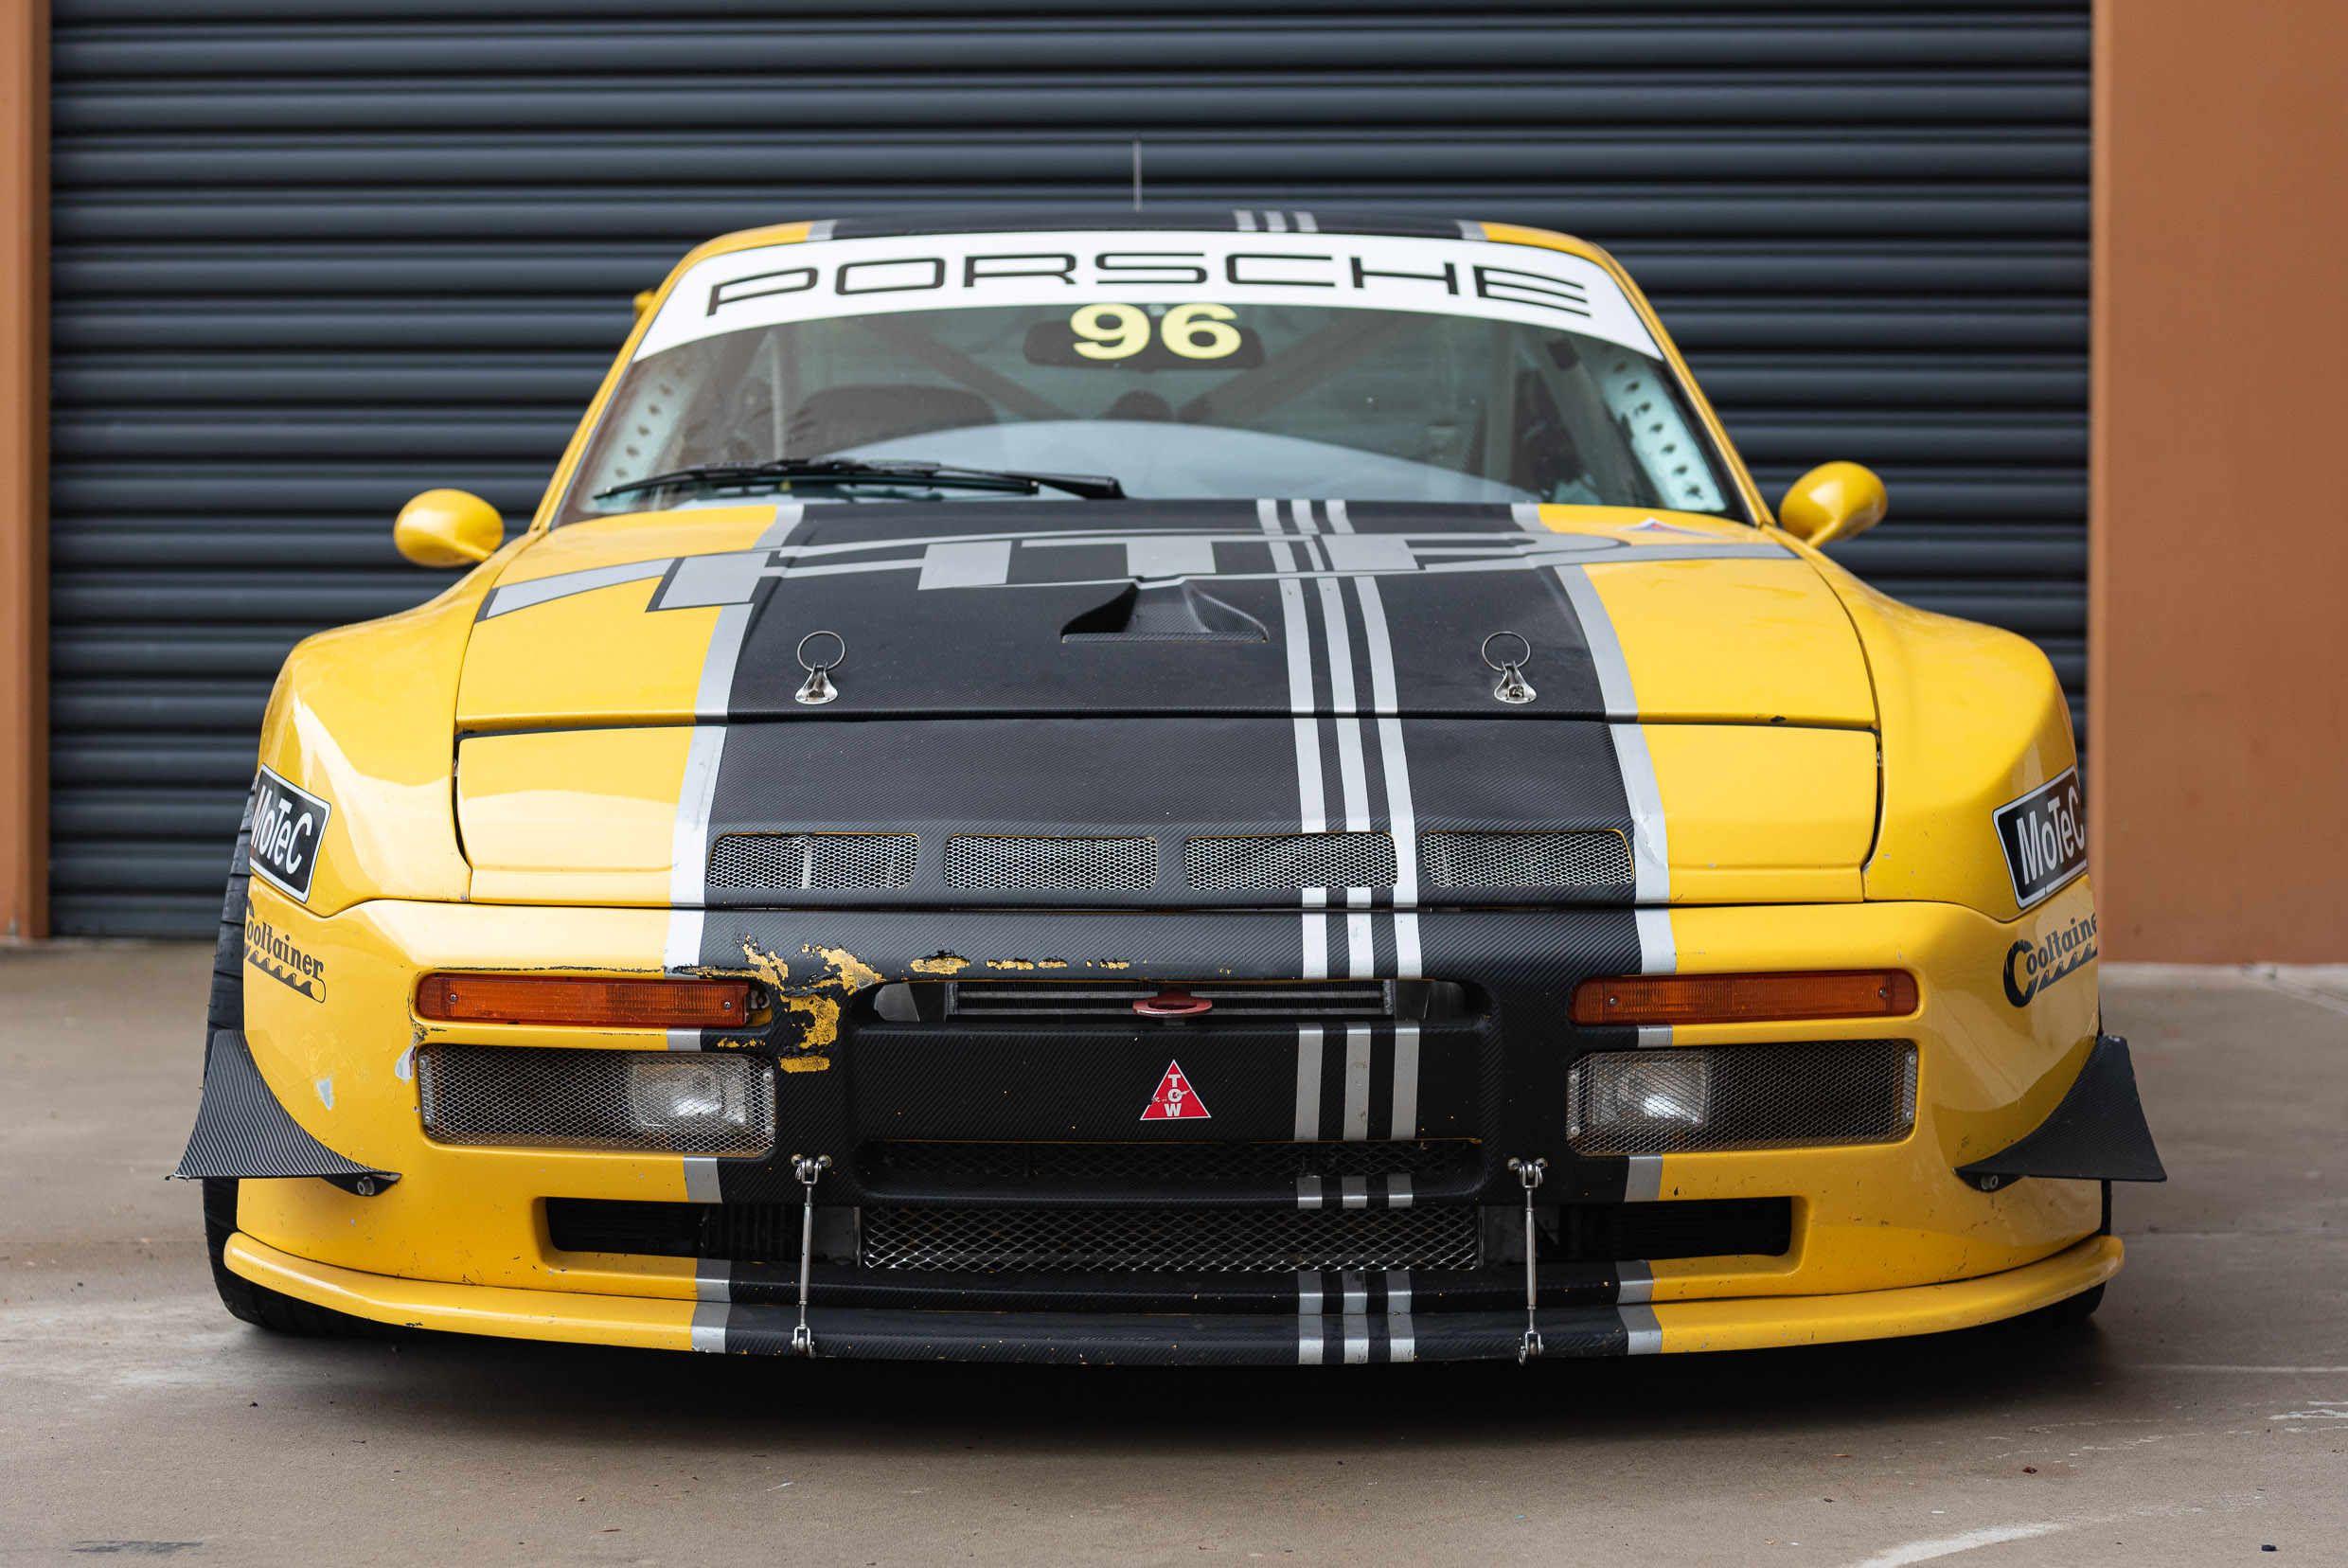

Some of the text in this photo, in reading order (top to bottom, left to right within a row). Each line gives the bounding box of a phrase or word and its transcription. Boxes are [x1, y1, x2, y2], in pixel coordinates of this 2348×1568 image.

[705, 252, 1592, 317] PORSCHE
[1070, 303, 1242, 360] 96
[251, 784, 312, 874] MoTeC
[2017, 785, 2085, 885] MoTeC
[243, 900, 324, 978] ooltainer
[2003, 912, 2097, 1007] Cooltaine
[1164, 1074, 1183, 1117] TOW
